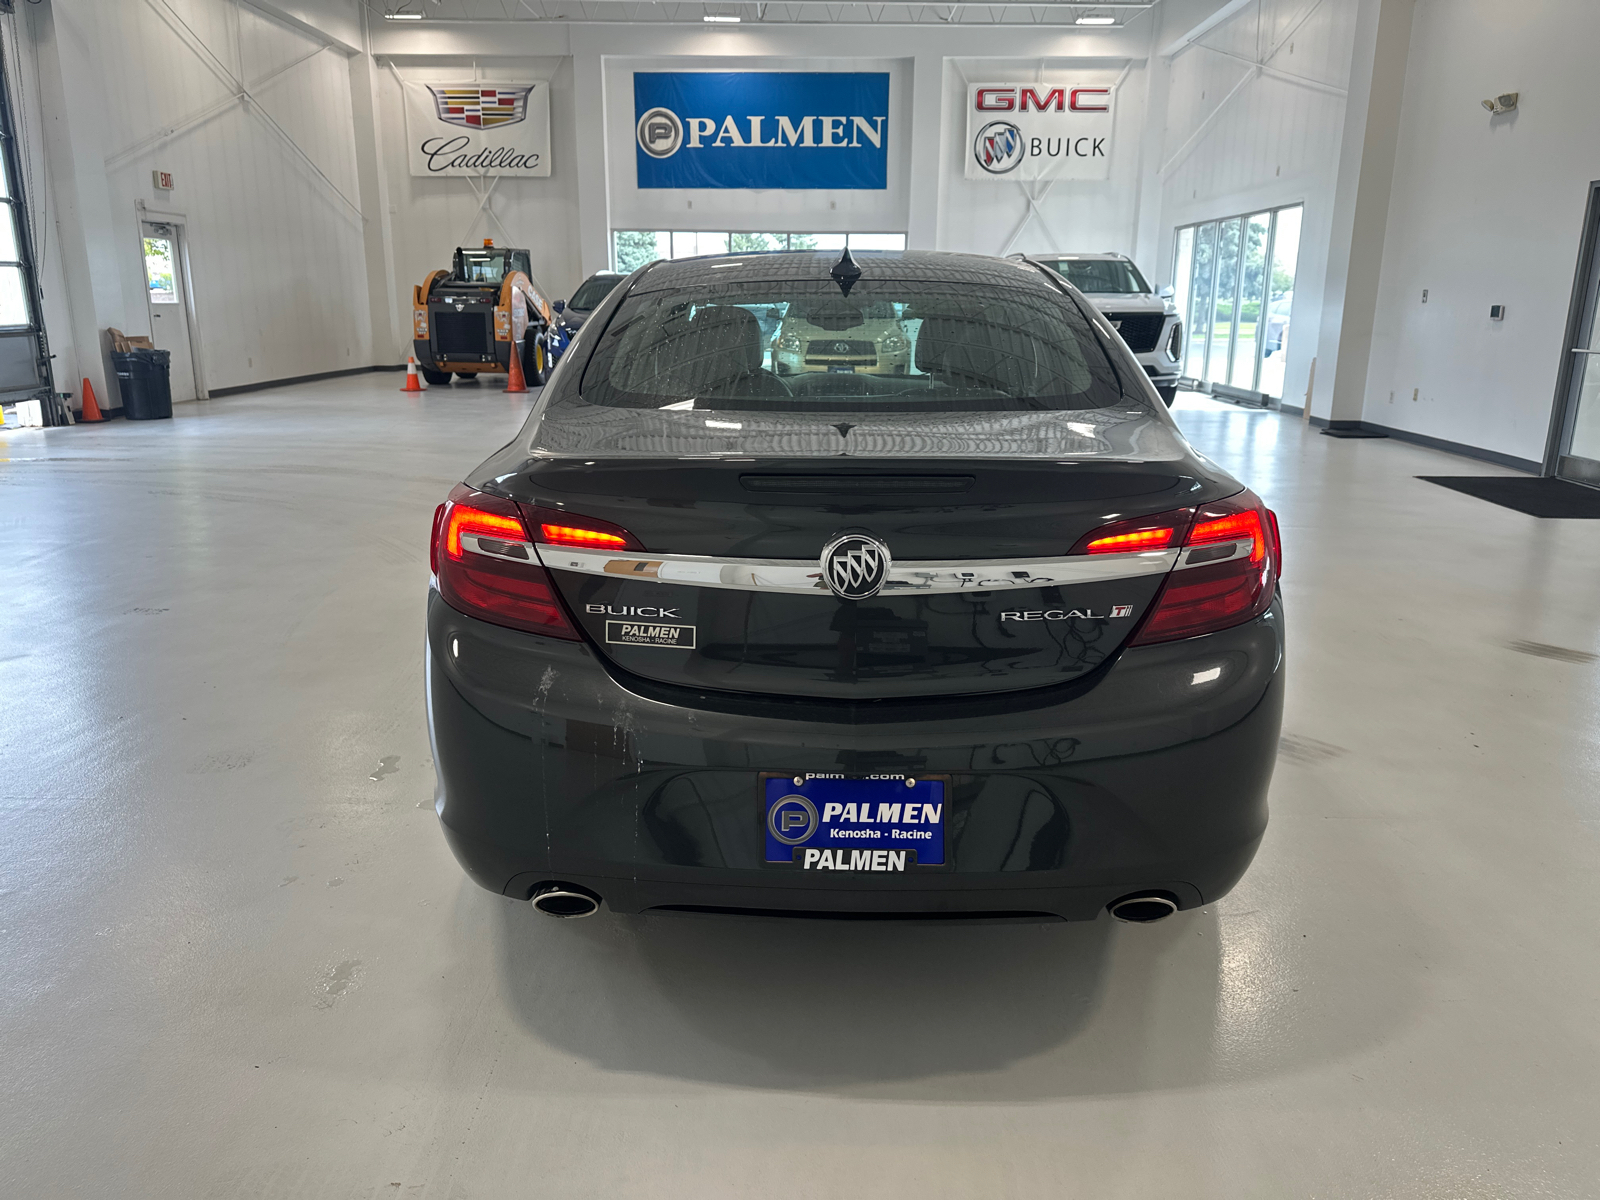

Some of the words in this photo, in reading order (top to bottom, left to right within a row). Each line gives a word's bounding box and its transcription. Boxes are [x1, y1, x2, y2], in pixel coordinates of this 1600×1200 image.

[975, 87, 1110, 113] GMC
[685, 115, 886, 149] PALMEN
[421, 136, 539, 172] Cadillac
[1030, 137, 1106, 157] BUICK
[160, 172, 172, 188] EXIT
[585, 603, 682, 618] BUICK
[1001, 609, 1104, 621] REGAL
[621, 625, 680, 638] PALMEN
[805, 772, 905, 780] palm.com
[822, 802, 942, 824] PALMEN
[830, 828, 881, 838] Kenosha
[892, 829, 932, 839] Racine
[804, 849, 906, 871] PALMEN
